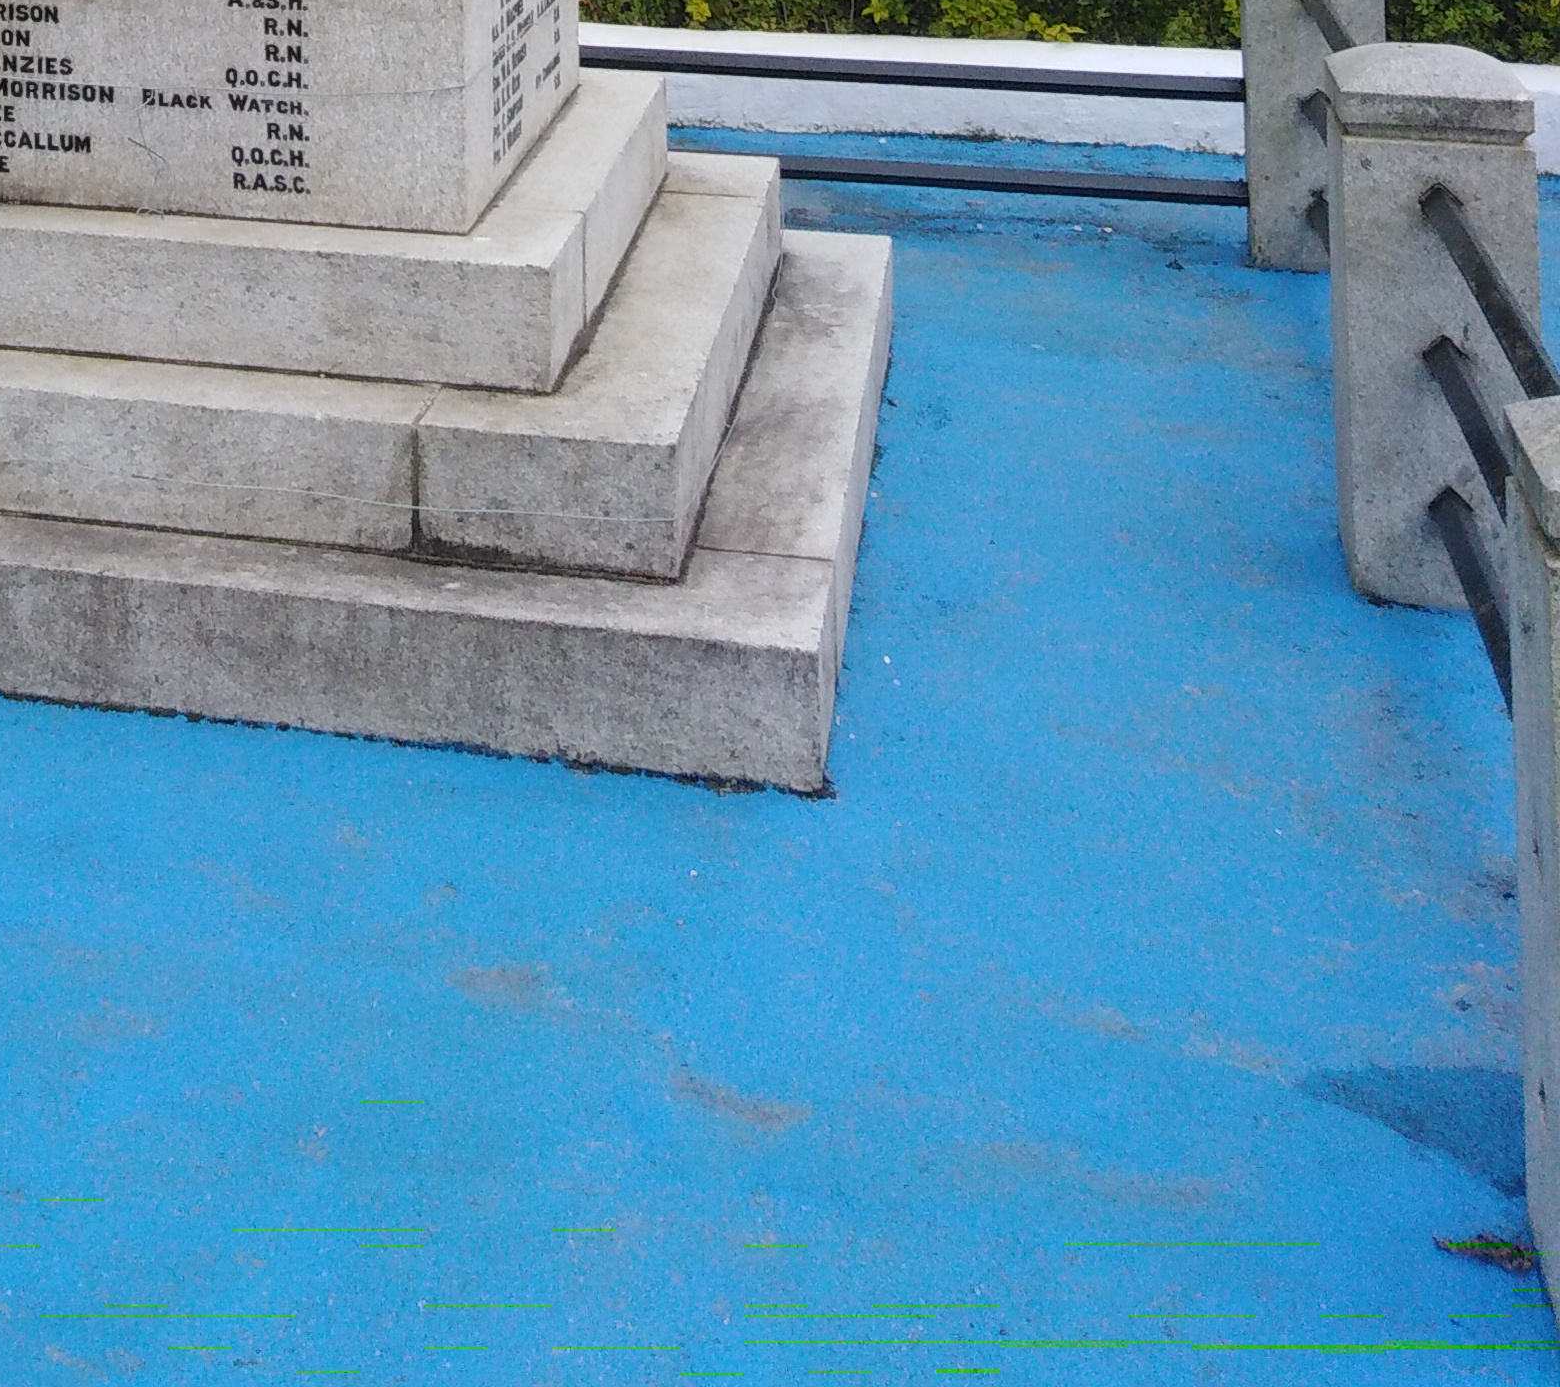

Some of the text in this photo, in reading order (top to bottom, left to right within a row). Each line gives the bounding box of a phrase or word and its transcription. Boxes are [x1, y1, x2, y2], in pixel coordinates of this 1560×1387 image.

[264, 17, 308, 37] R.N.
[265, 44, 308, 64] R.N.
[142, 88, 212, 109] BLACK
[267, 122, 309, 141] R.N.
